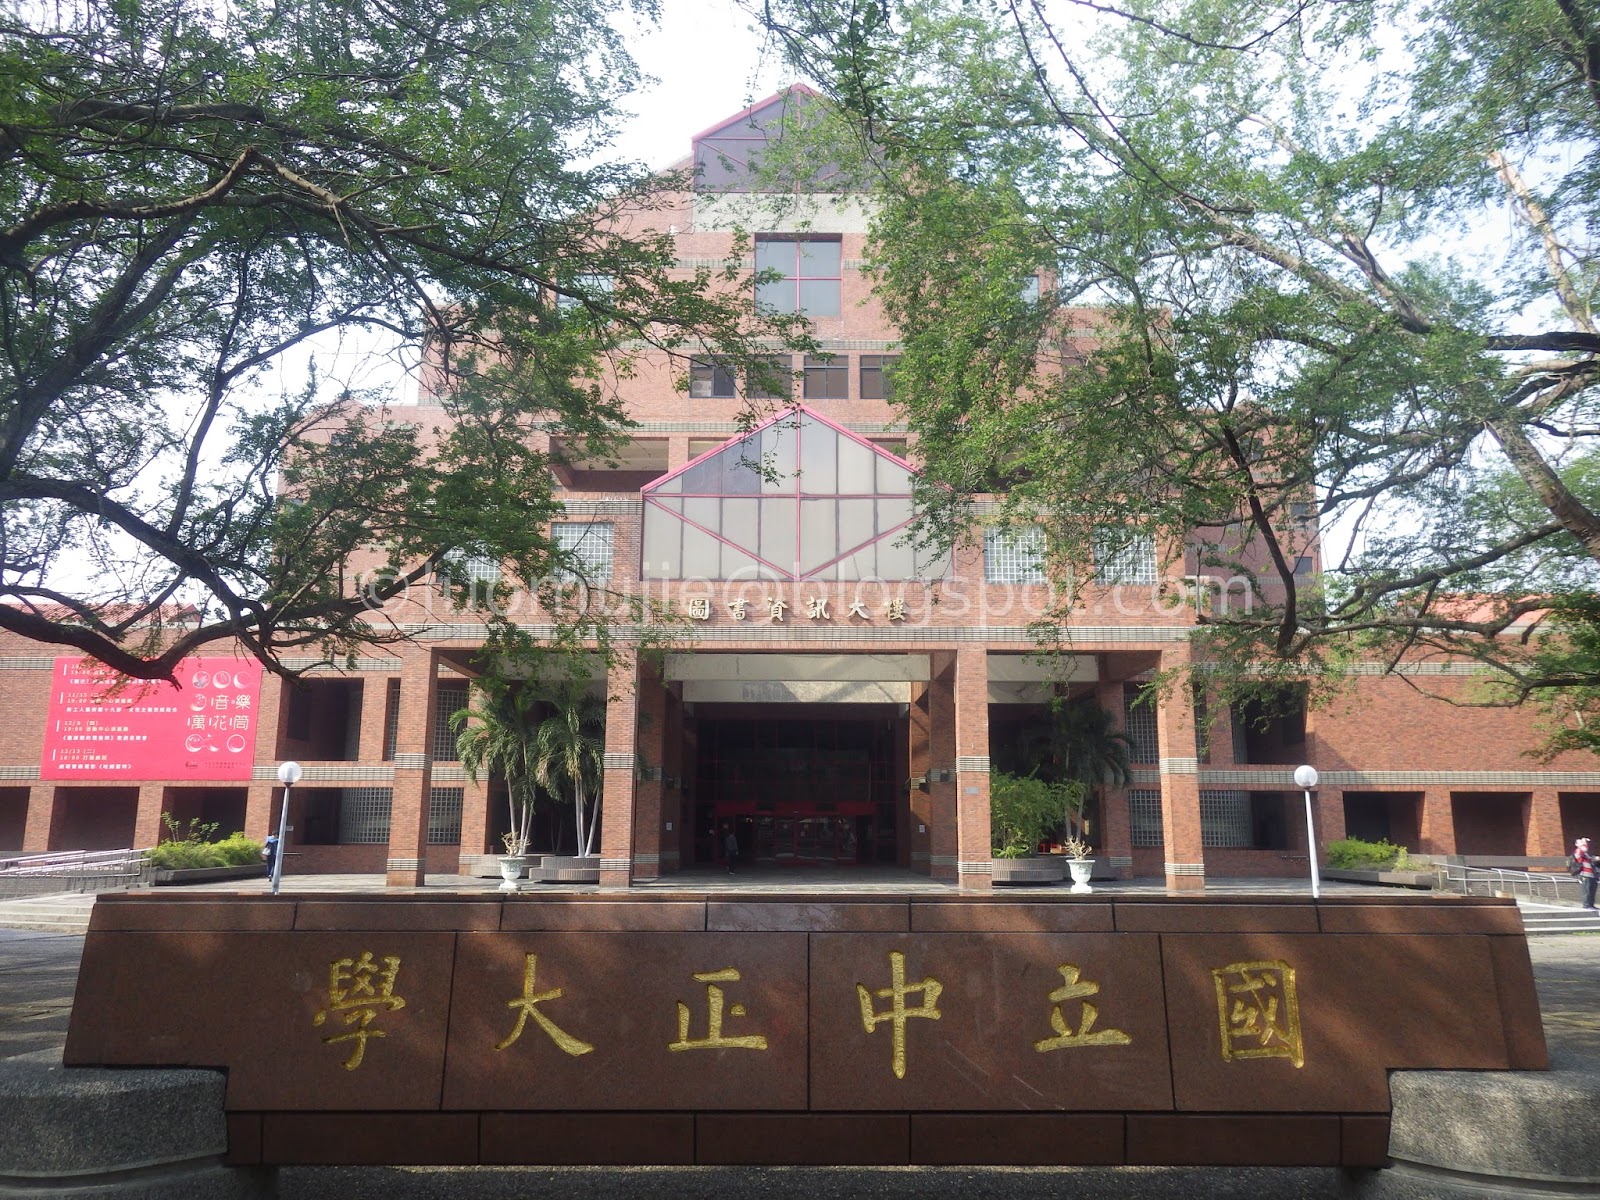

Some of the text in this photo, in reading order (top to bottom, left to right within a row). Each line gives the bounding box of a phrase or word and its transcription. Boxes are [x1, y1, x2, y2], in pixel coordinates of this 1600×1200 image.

[688, 595, 907, 621] 圖書資訊大樓
[215, 694, 251, 710] 音樂
[191, 714, 249, 731] 萬花筒
[312, 950, 1307, 1080] 國立中正大學
